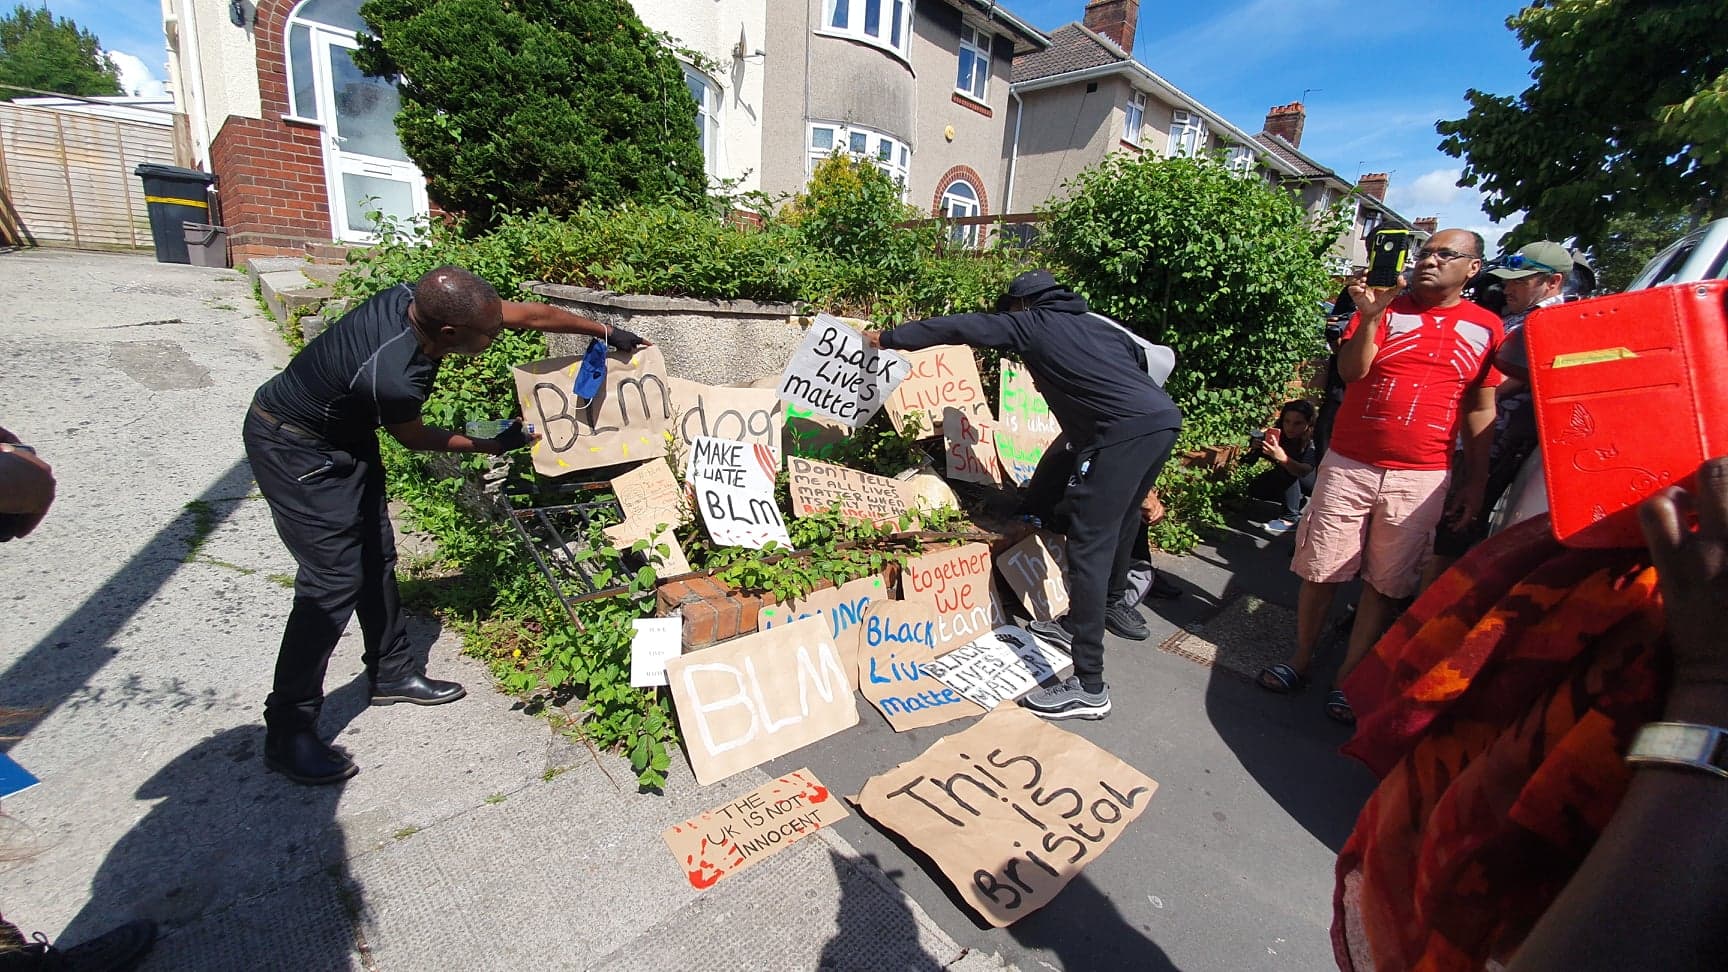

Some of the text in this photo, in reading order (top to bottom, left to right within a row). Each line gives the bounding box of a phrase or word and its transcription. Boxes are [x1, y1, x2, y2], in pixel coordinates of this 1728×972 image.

[816, 360, 878, 401] Lives
[693, 438, 744, 467] MAKE
[798, 486, 862, 502] MATTER
[827, 480, 856, 492] ALL
[862, 485, 899, 499] LIVES
[855, 471, 895, 489] TELL
[911, 552, 989, 593] together
[931, 591, 1006, 647] tand
[923, 641, 991, 678] BLACK
[946, 654, 1005, 693] LIVES
[682, 642, 848, 758] BLM
[880, 688, 961, 716] matte
[715, 792, 765, 820] THE
[886, 749, 1042, 827] This
[706, 794, 801, 846] UK IS NOT
[733, 809, 823, 860] INNOCENT
